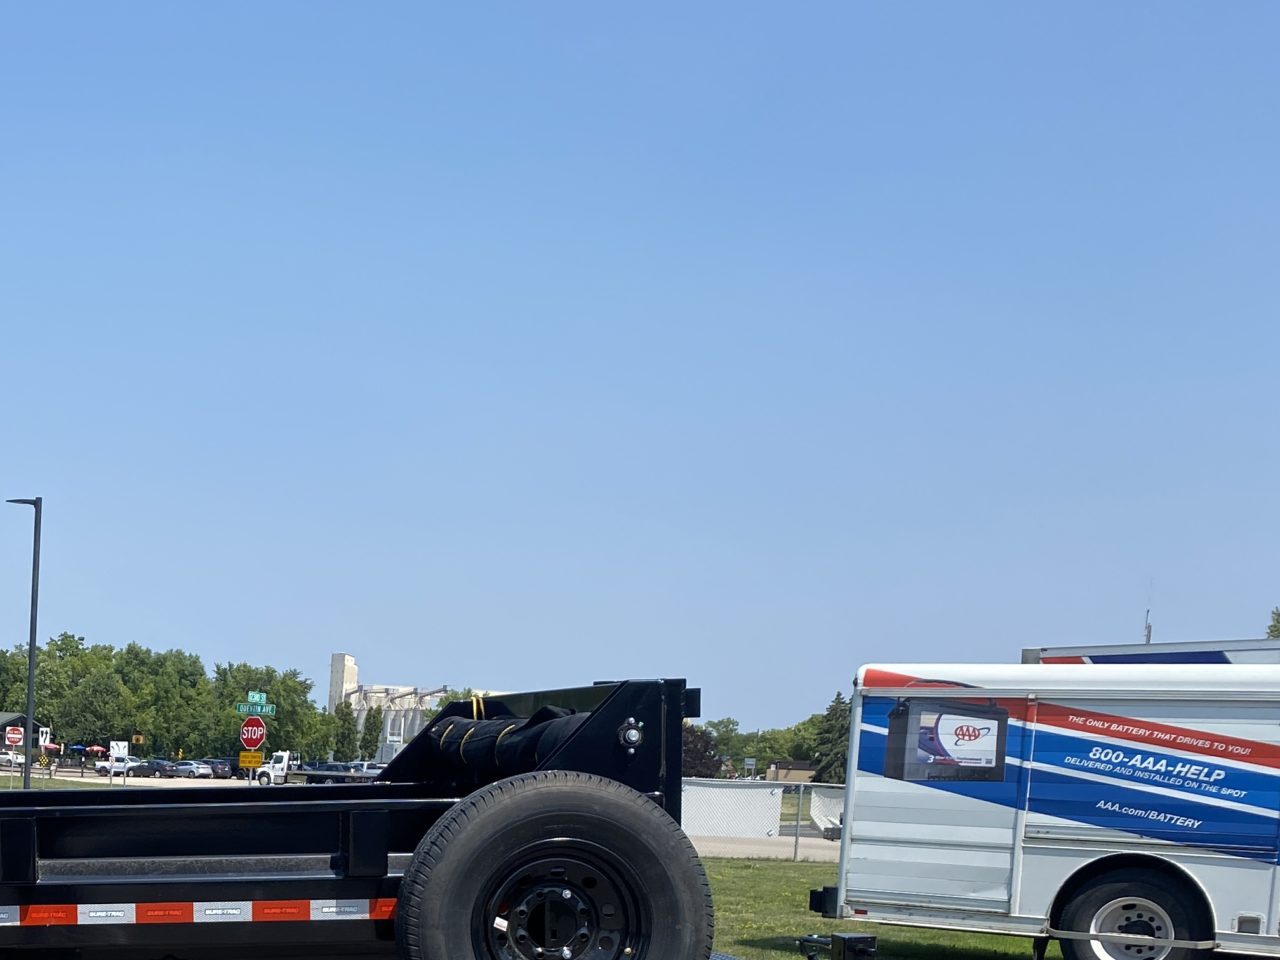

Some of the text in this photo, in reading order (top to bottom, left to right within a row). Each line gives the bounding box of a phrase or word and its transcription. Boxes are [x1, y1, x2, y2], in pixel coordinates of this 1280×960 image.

[242, 727, 263, 739] STOP
[955, 725, 980, 741] AAA
[1068, 716, 1252, 755] THE ONLY BATTERY THAT DRIVES TO YOU!
[1064, 756, 1112, 771] DELIVERED
[1114, 766, 1133, 776] AND
[1134, 770, 1183, 786] INSTALLED
[1201, 784, 1220, 792] THE
[1221, 788, 1248, 798] SPOT
[1089, 747, 1226, 782] 800-AAA-HELP
[1096, 800, 1202, 828] AAA.com/BATTERY
